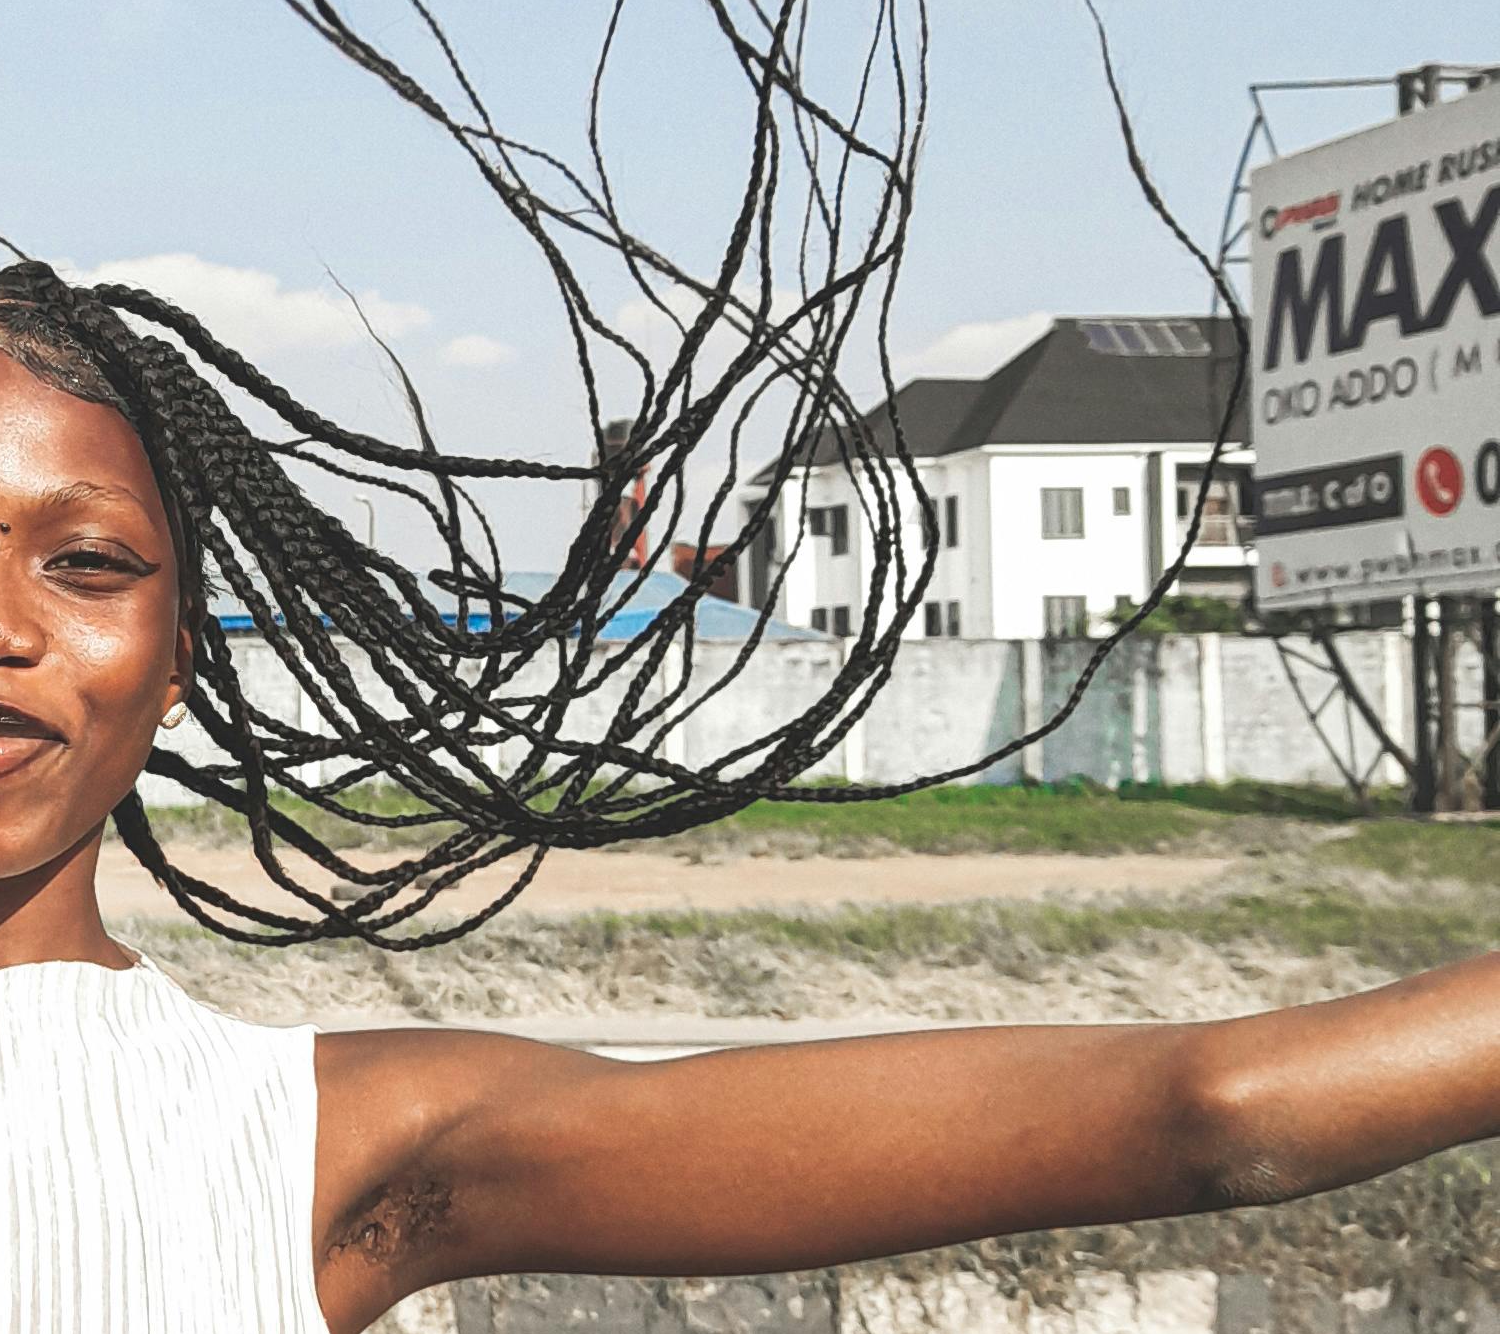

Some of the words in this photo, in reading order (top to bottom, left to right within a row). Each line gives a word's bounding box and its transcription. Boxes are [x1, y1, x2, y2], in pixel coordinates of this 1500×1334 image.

[1351, 161, 1431, 211] HOME
[1437, 136, 1500, 185] RUS
[1262, 182, 1500, 371] MAX
[1328, 356, 1419, 410] ADDO
